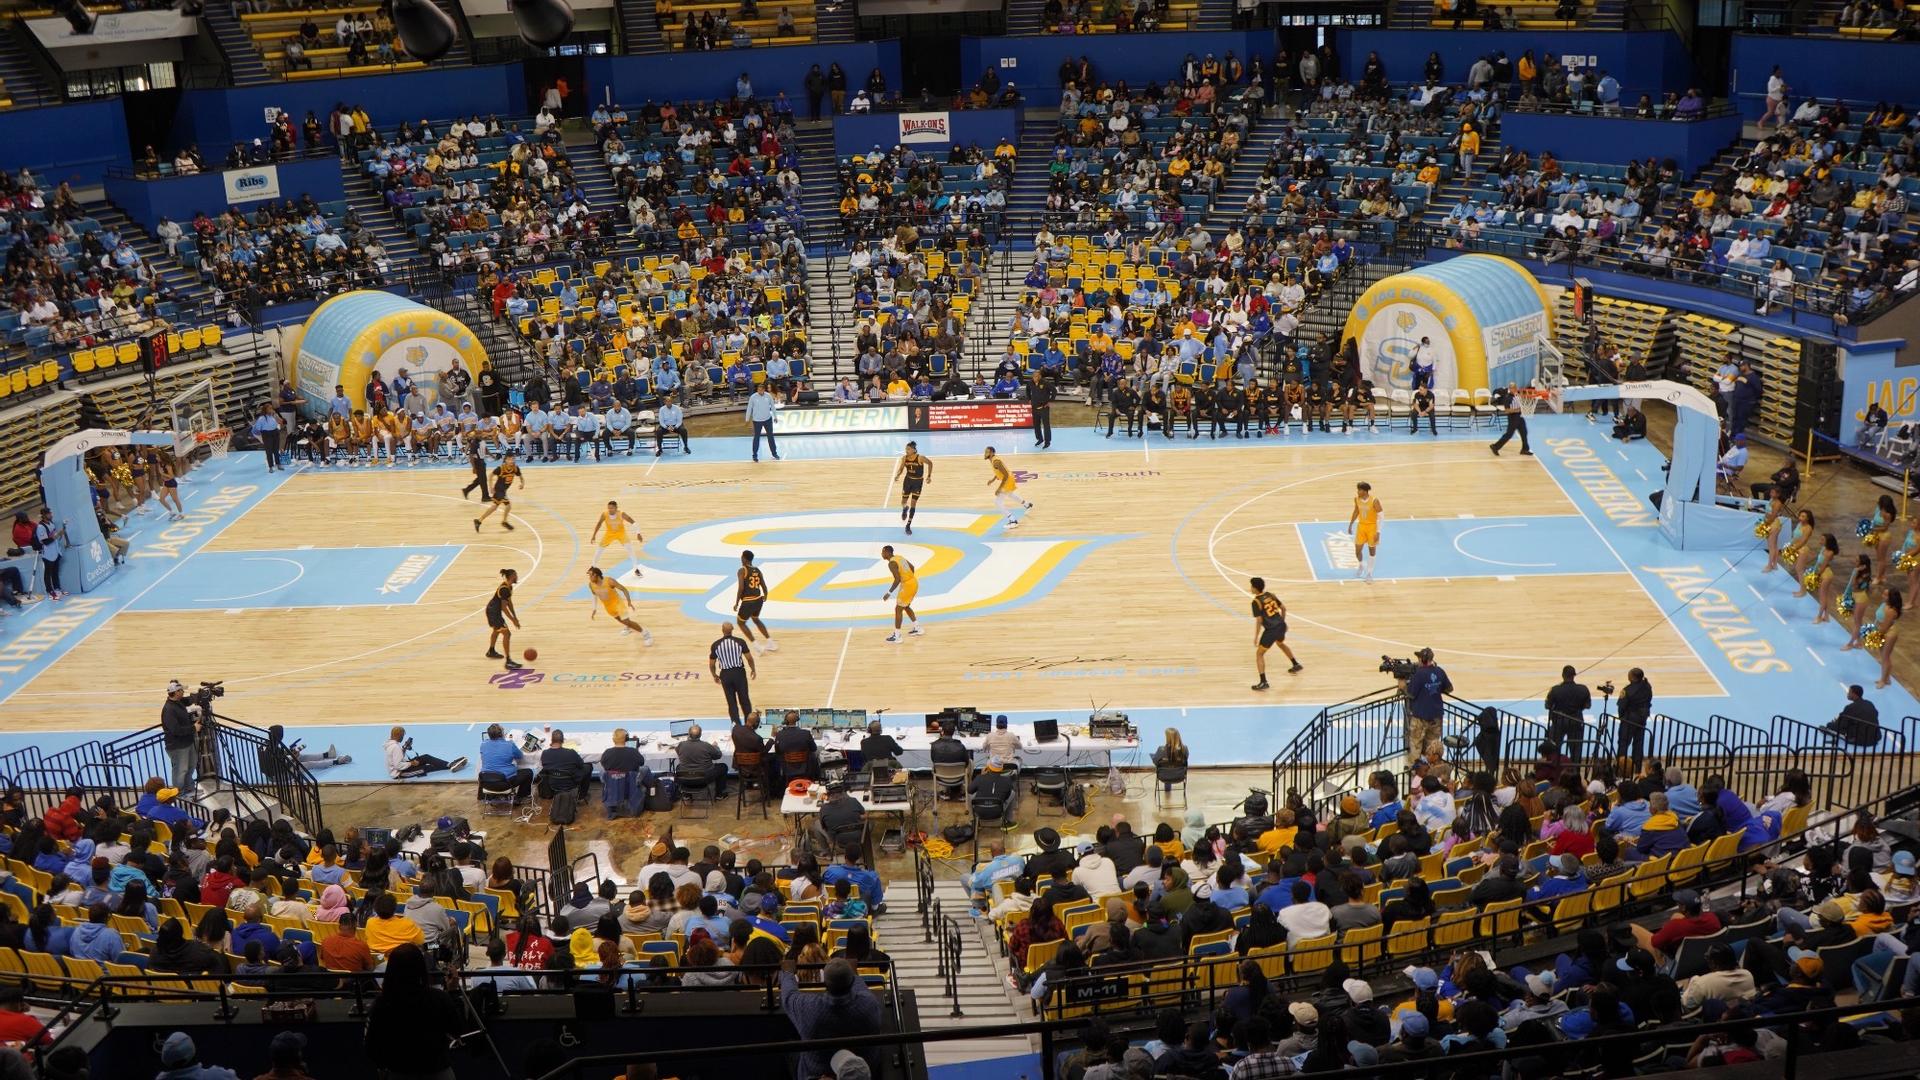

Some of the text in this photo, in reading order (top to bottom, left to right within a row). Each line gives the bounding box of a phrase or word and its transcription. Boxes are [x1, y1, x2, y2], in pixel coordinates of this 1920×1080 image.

[239, 177, 265, 188] Ribs
[379, 320, 460, 350] ALL IN
[774, 407, 901, 431] SOUTHERN
[1544, 438, 1661, 528] SOUTHERN
[130, 484, 260, 559] JAGUARS
[749, 576, 761, 589] 32
[1264, 600, 1281, 617] 23
[1640, 564, 1793, 674] JAGUARS
[552, 671, 700, 683] CareSouth
[1077, 984, 1117, 998] M-11
